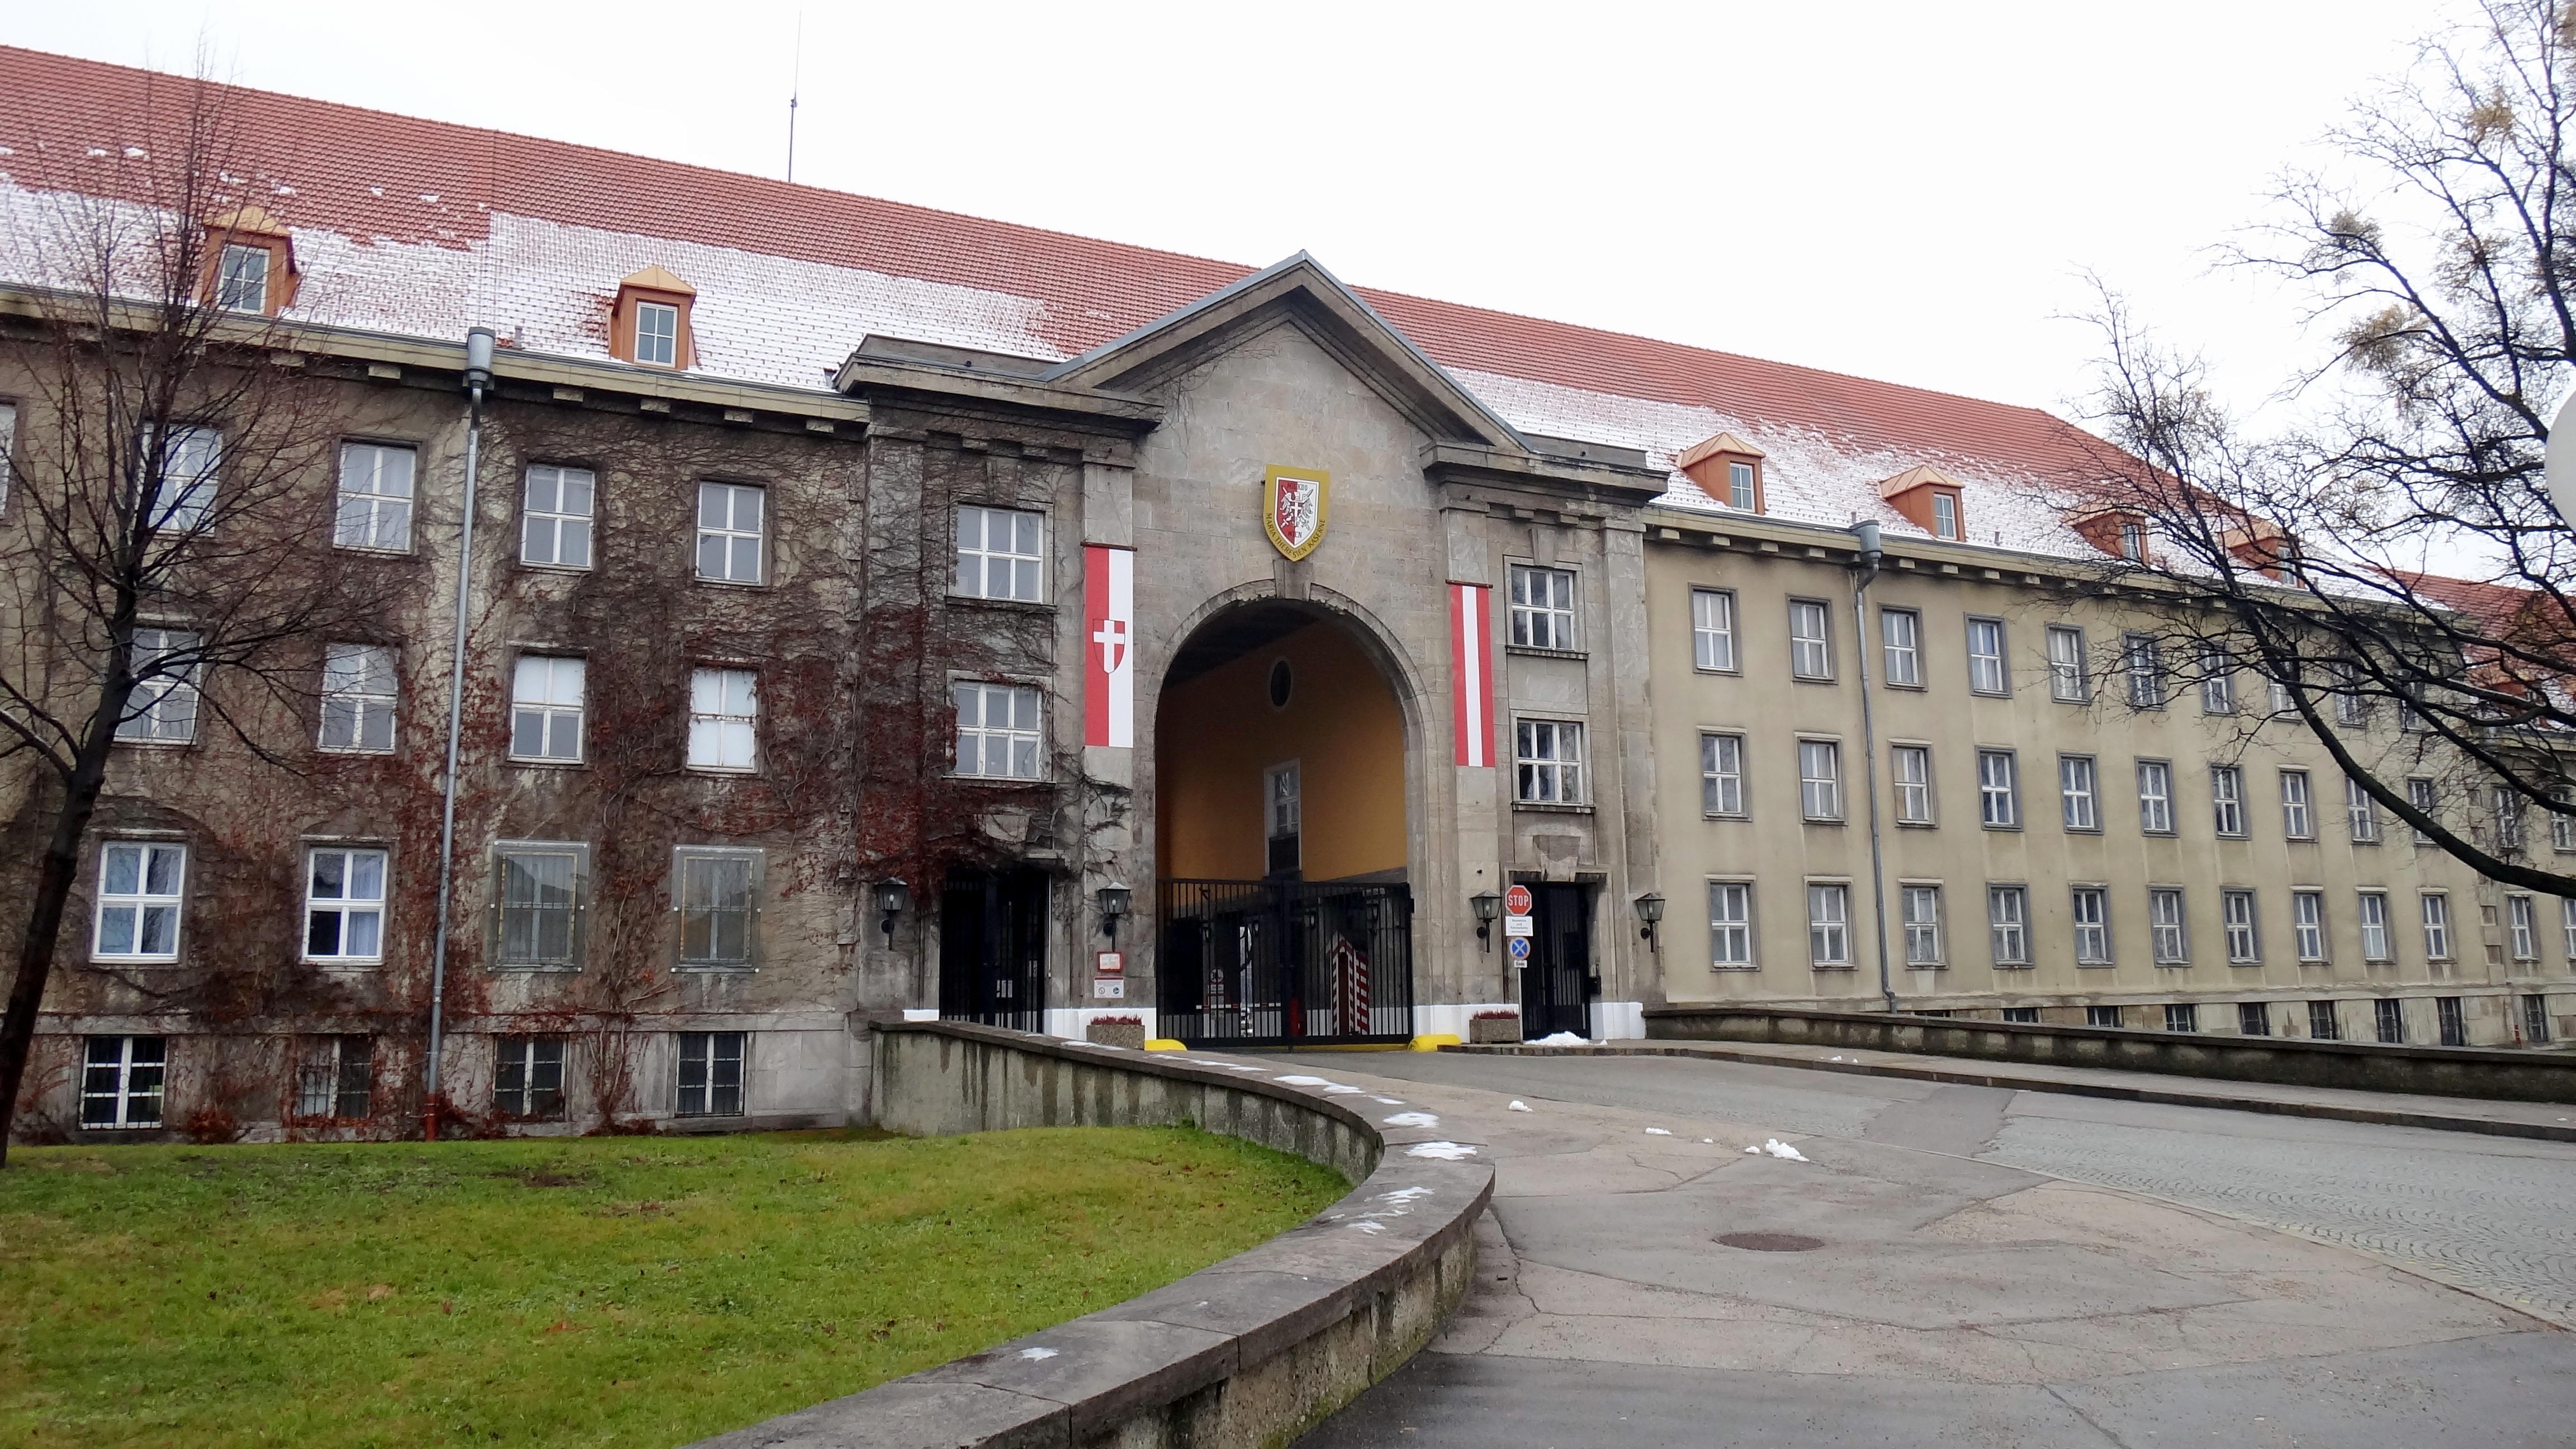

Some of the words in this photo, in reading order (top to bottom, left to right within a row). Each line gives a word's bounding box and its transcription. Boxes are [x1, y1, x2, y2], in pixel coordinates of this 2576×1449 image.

[1266, 513, 1276, 537] MARIA
[1275, 535, 1307, 558] THERESIEN
[1308, 518, 1325, 548] KASERNE
[1508, 895, 1528, 906] STOP
